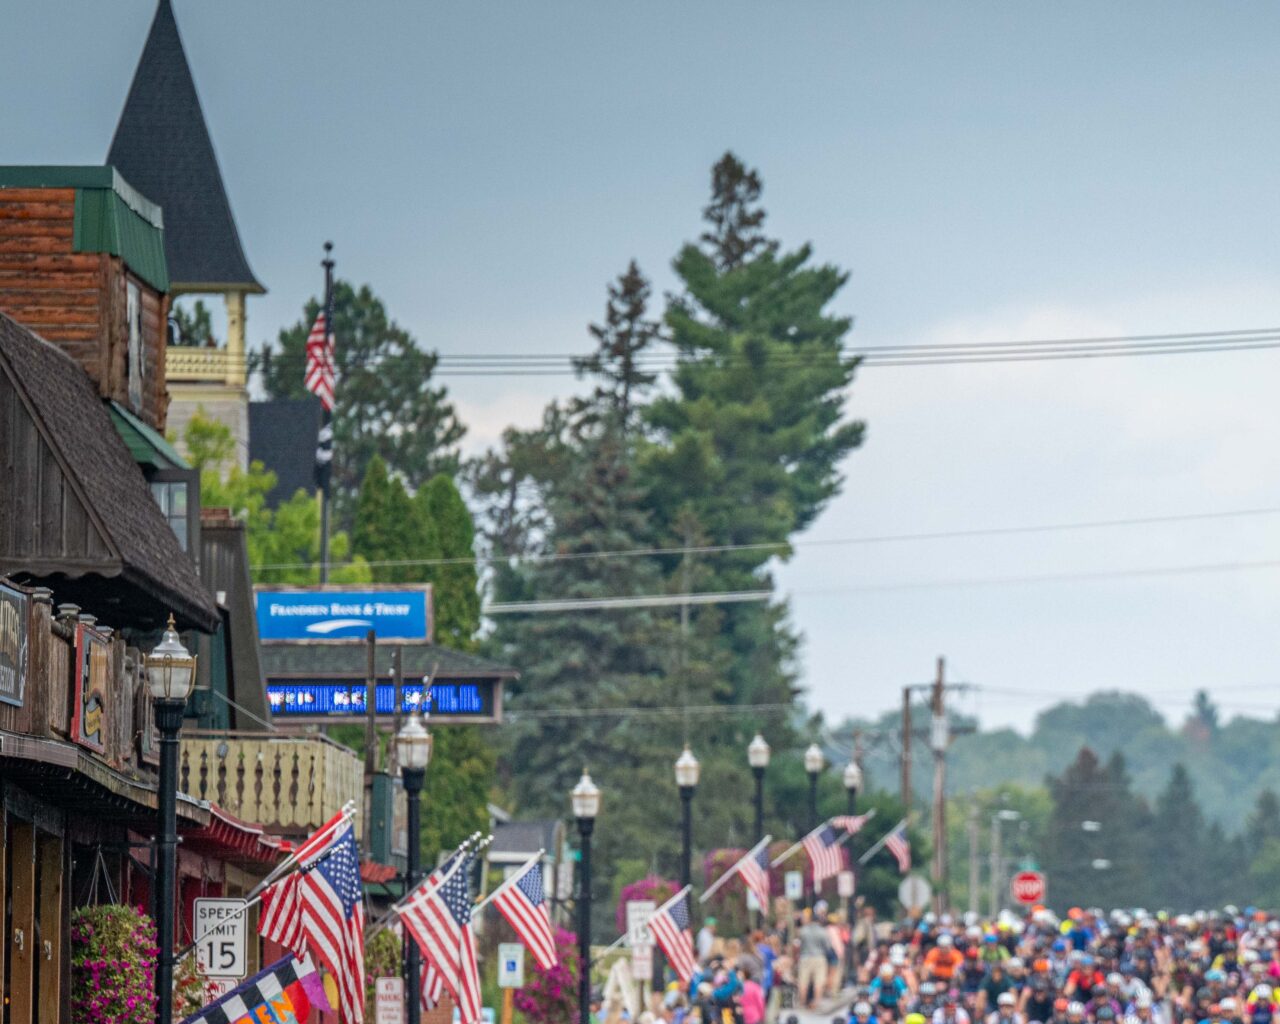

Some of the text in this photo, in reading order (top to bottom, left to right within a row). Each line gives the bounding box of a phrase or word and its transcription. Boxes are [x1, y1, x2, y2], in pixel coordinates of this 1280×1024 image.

[270, 603, 411, 616] FRANDSEN BANK & TRUST
[1014, 881, 1042, 894] STOP
[207, 942, 235, 969] 15
